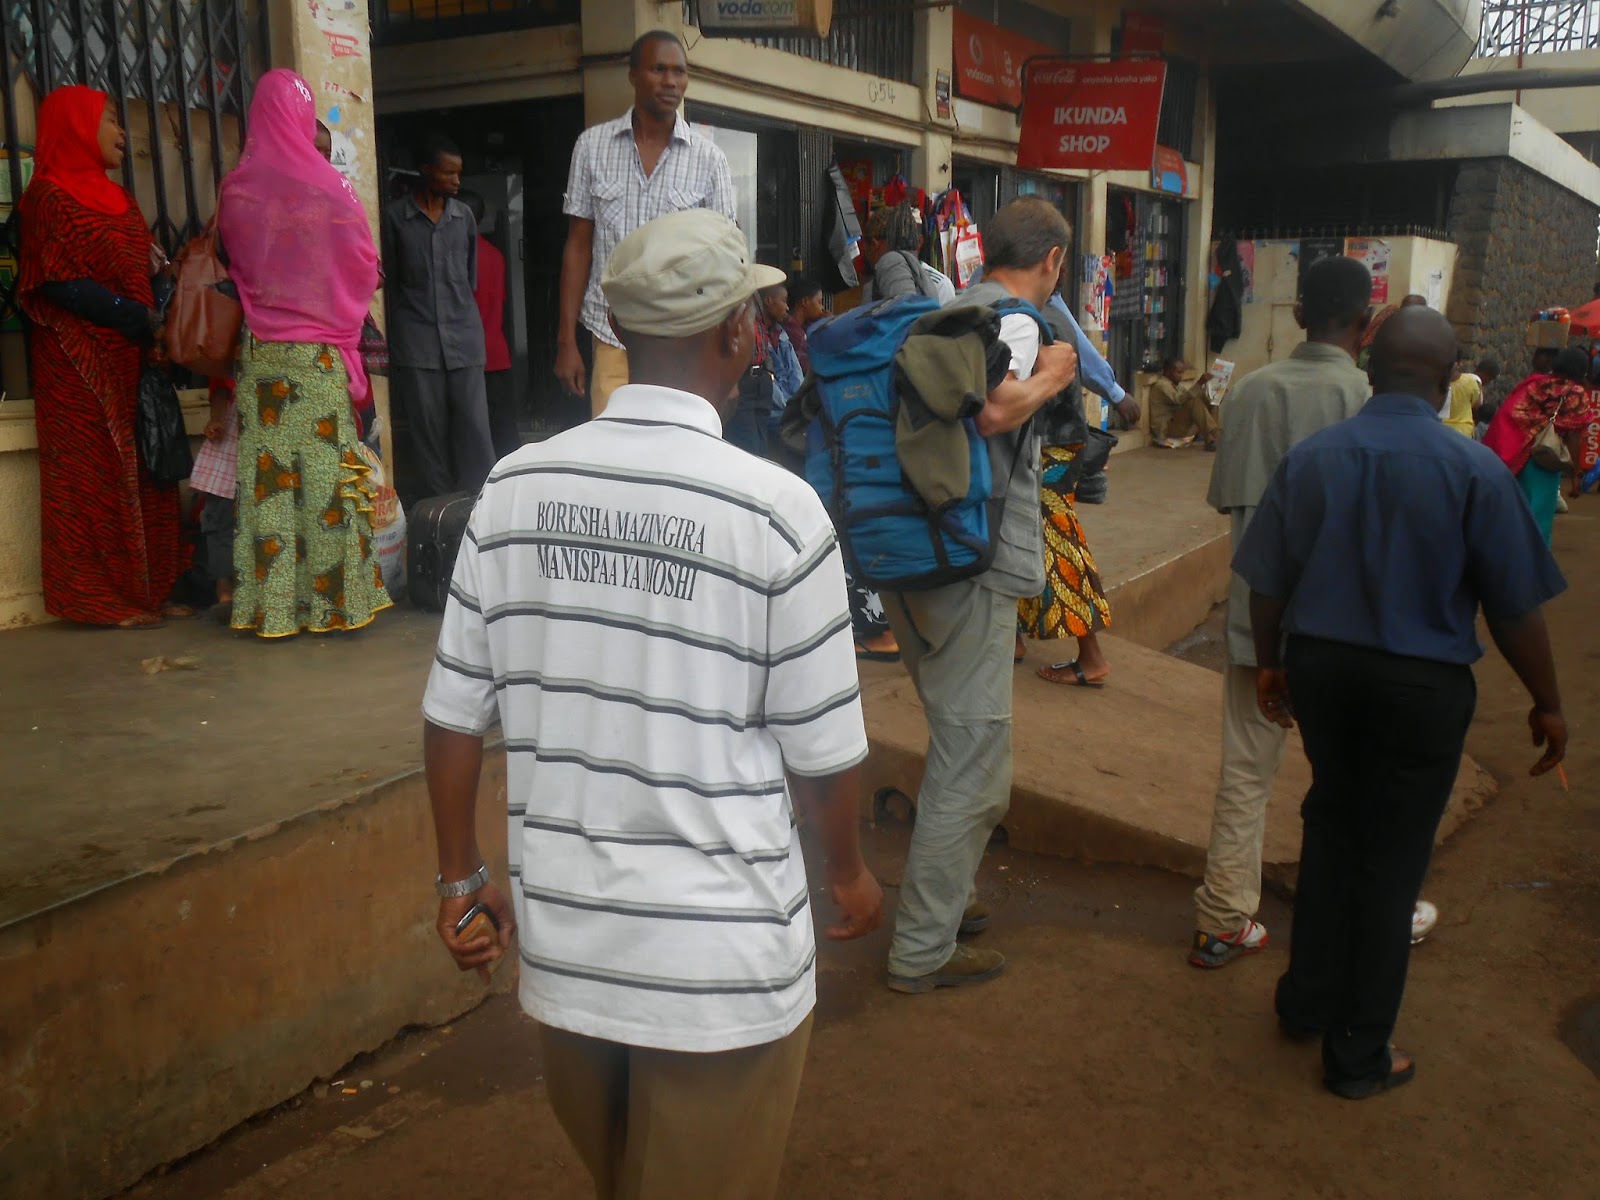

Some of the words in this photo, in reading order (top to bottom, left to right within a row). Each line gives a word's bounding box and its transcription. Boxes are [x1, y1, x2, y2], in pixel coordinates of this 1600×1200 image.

[717, 0, 793, 15] vodacom
[1054, 106, 1128, 125] IKUNDA
[1058, 135, 1111, 152] SHOP
[536, 501, 611, 539] BORESHA
[614, 510, 706, 554] MAZINGIRA
[536, 544, 617, 586] MANISPAA
[622, 555, 640, 590] YA
[642, 557, 698, 601] MOSHI
